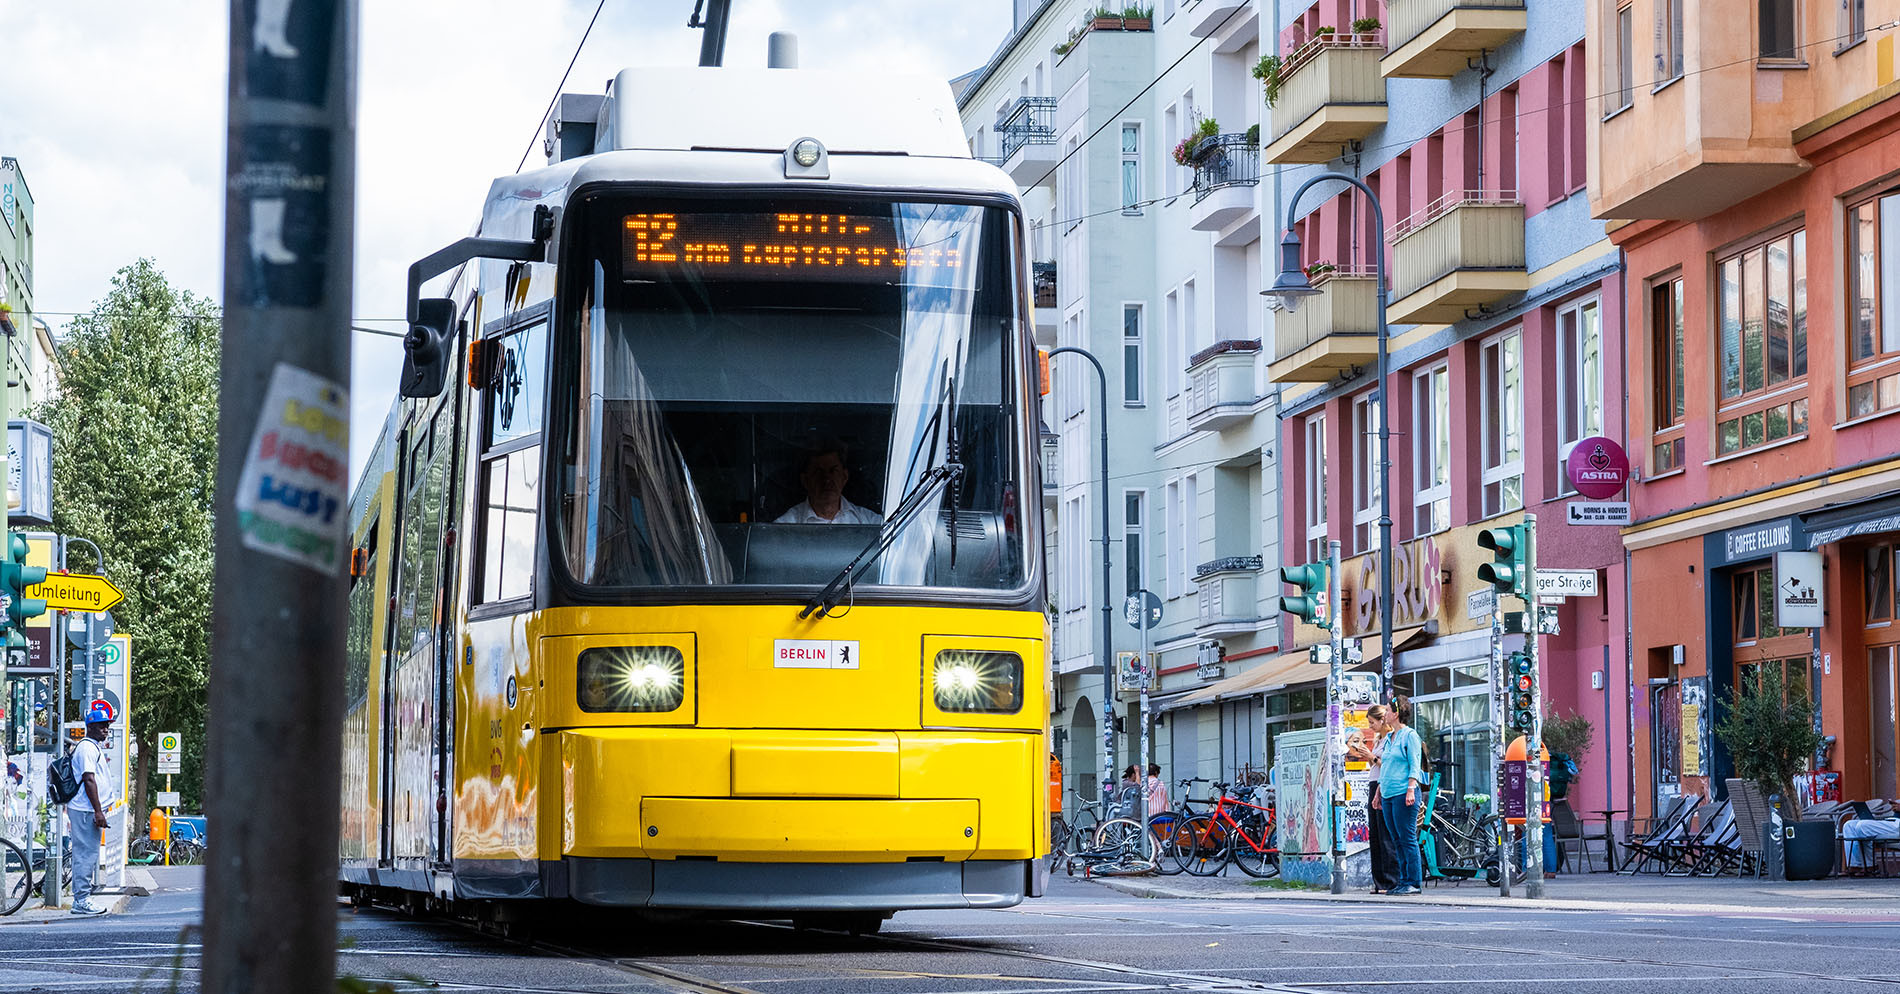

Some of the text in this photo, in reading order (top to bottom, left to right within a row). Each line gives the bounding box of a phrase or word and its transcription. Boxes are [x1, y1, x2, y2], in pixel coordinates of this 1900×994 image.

[627, 213, 677, 262] 12
[1581, 471, 1619, 480] ASTRA
[1856, 520, 1882, 534] COFFEE
[1735, 525, 1790, 554] COFFEE FELLOWS
[1536, 576, 1592, 591] iger Straße
[32, 584, 101, 606] Umleitung
[780, 648, 826, 659] BERLIN
[1122, 674, 1140, 683] Berliner
[491, 719, 502, 739] BVG
